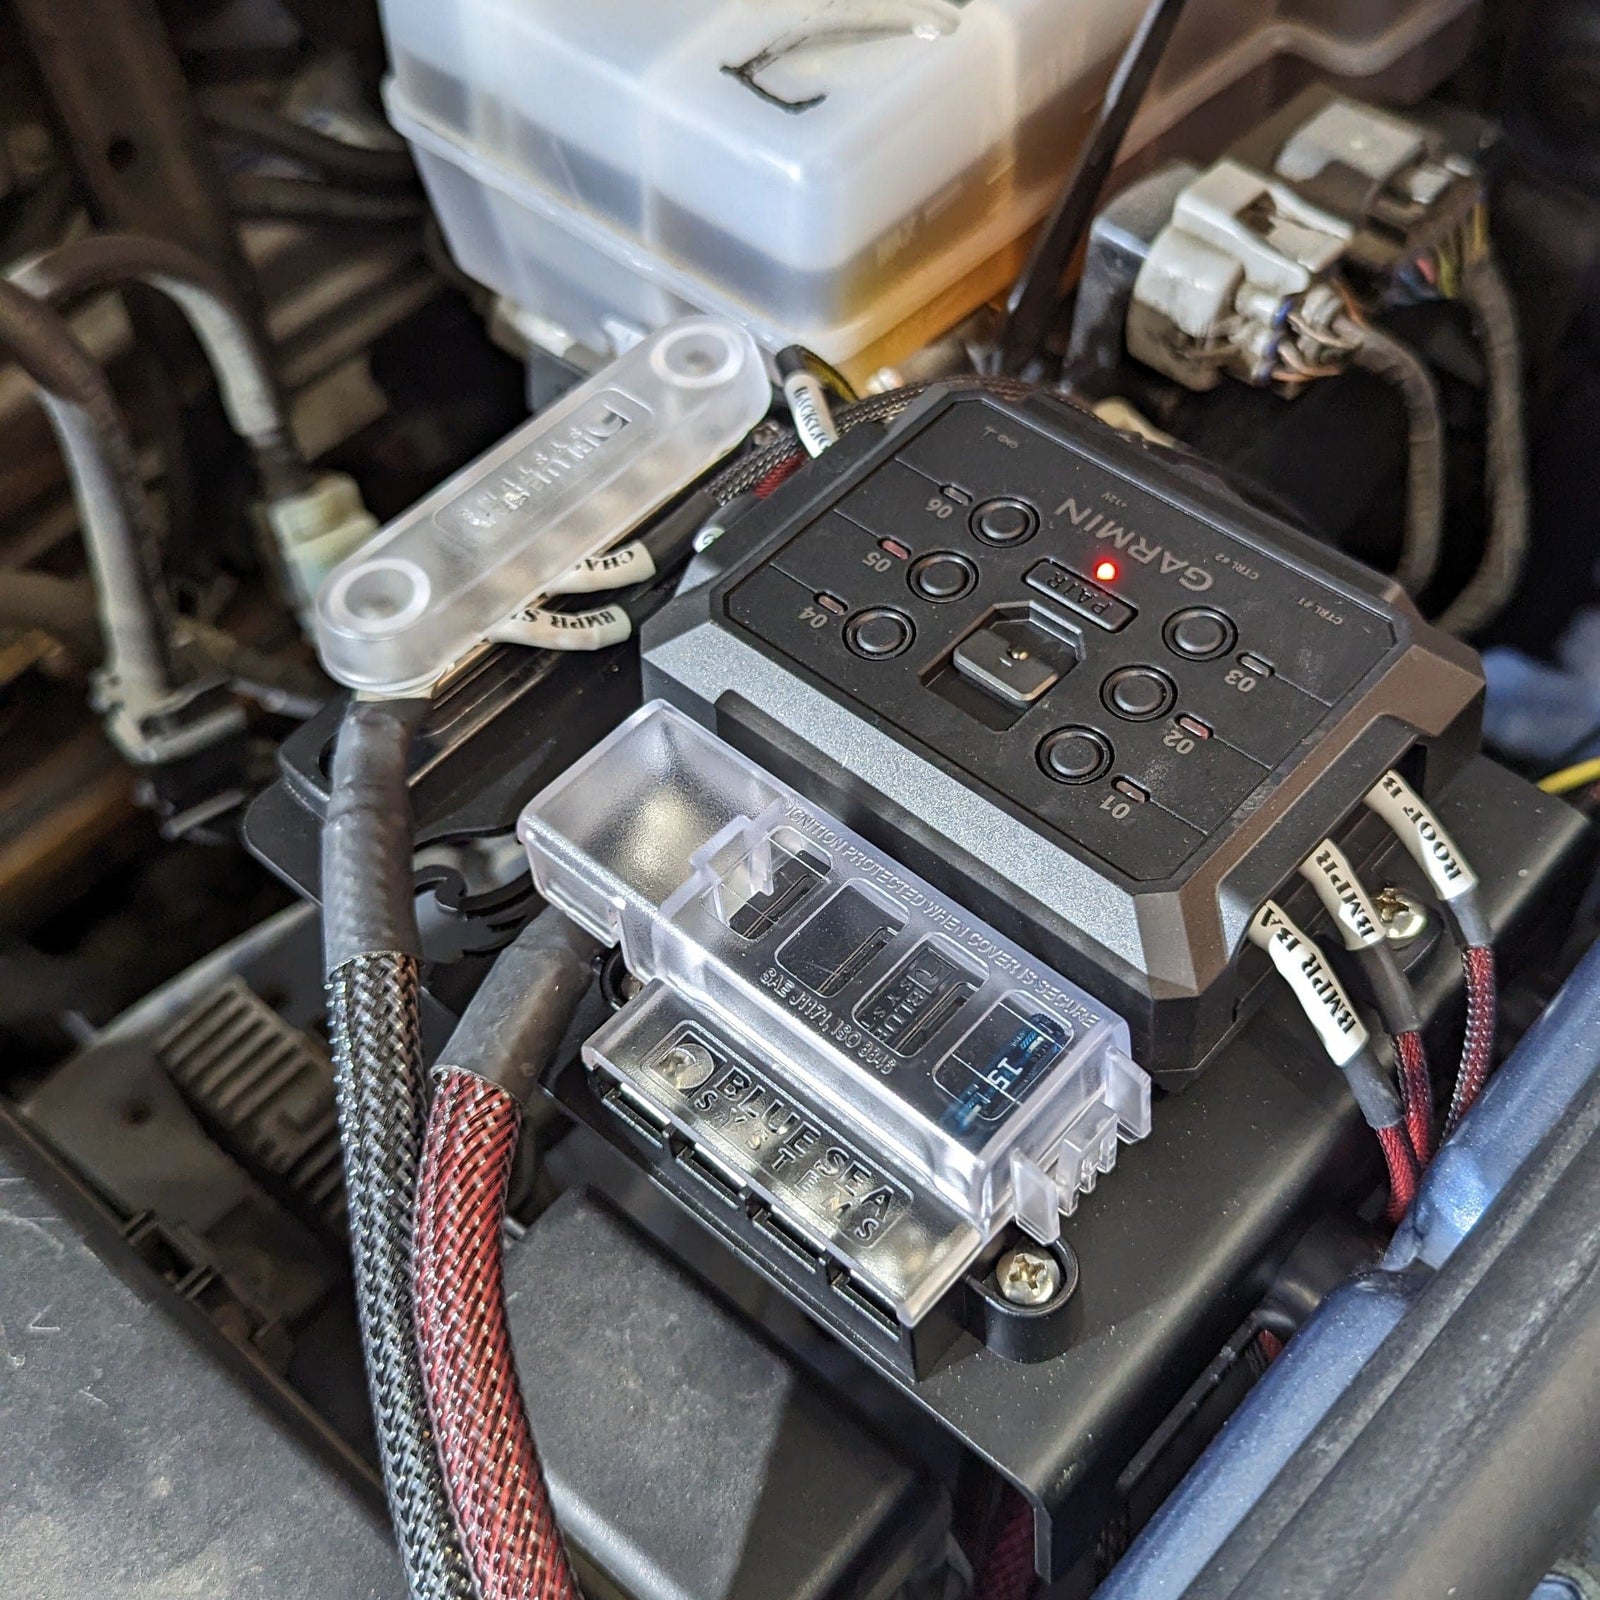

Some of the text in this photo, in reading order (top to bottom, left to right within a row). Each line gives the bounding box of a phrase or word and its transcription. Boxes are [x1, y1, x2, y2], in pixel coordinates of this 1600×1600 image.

[925, 499, 953, 519] 06
[1101, 491, 1127, 508] +12V
[1053, 497, 1213, 592] GARMIN
[575, 549, 635, 572] CHA
[862, 552, 892, 573] 05
[1214, 553, 1260, 580] CTRL #2
[1047, 570, 1114, 617] PAIR
[510, 608, 617, 630] BMPR S
[798, 606, 828, 628] 04
[1315, 606, 1343, 626] CTRL
[1224, 669, 1257, 693] 03
[1162, 729, 1195, 754] 02
[1099, 794, 1131, 819] 01
[1402, 805, 1462, 881] ROOF
[1315, 849, 1377, 939] BMPR
[784, 802, 1101, 1029] IGNITION PROTECTED WHEN COVER IS SECURE
[1300, 952, 1357, 1035] BMPR
[759, 967, 796, 998] SAE
[830, 1017, 862, 1049] ISO
[987, 1056, 1024, 1091] 15
[715, 1064, 896, 1223] BLUE SEA
[694, 1089, 880, 1241] SYSTEMS
